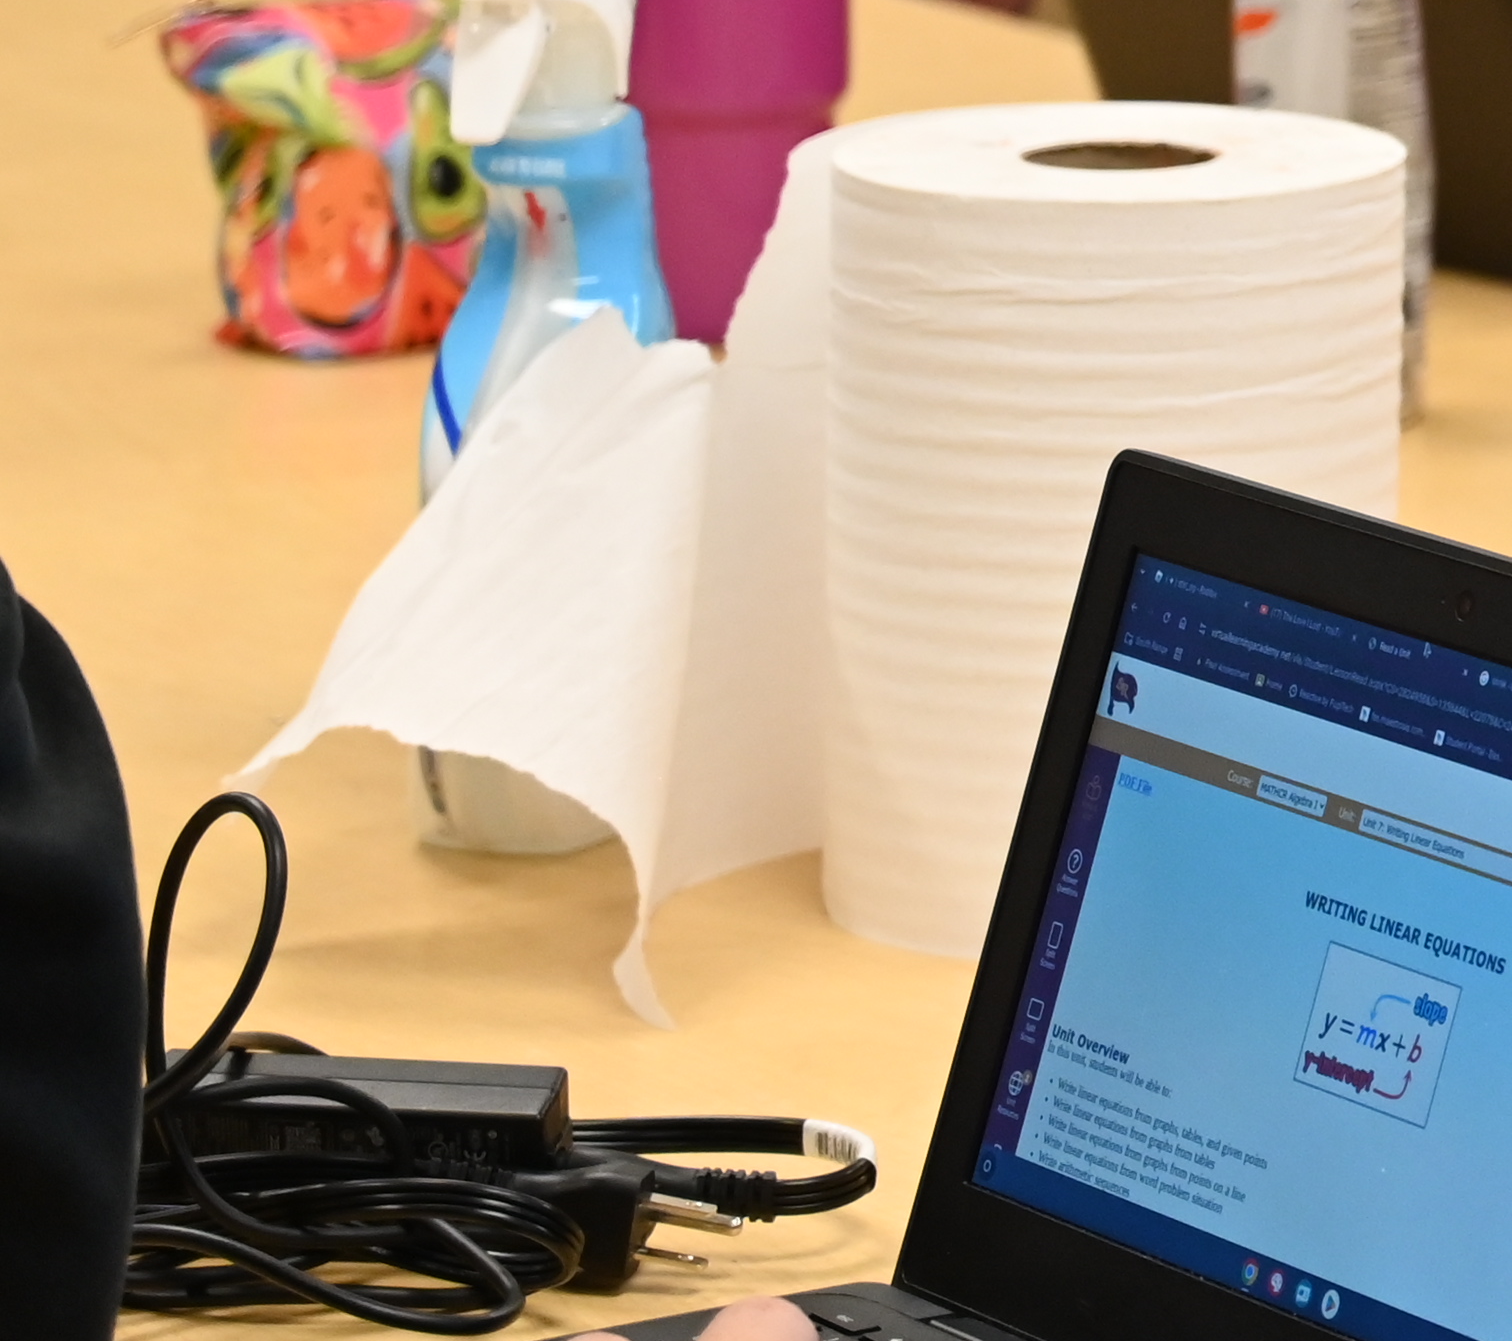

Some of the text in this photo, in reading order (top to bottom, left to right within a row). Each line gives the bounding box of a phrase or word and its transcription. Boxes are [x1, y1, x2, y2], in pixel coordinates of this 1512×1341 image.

[1289, 790, 1313, 809] Algebra
[1363, 818, 1378, 829] Unit
[1387, 824, 1409, 843] Writing
[1411, 833, 1431, 848] Linear
[1432, 840, 1465, 859] Equations
[1305, 890, 1507, 975] WRITING LINEAR EQUATIONS
[1413, 993, 1448, 1027] slope
[1052, 1024, 1130, 1065] Unit Overview
[1057, 1044, 1070, 1059] this
[1089, 1058, 1118, 1078] students
[1120, 1068, 1134, 1084] will
[1135, 1073, 1144, 1087] be
[1145, 1079, 1159, 1094] able
[1161, 1085, 1172, 1099] to:
[1303, 1050, 1375, 1094] y-intercept
[1053, 1096, 1215, 1169] Write linear equations from graphs from tables
[1058, 1078, 1268, 1169] Write linear equations from graphs, tables, and given points
[1043, 1132, 1223, 1214] Write linear equations from word problem situation
[1048, 1114, 1246, 1203] Write linear equations from graphs from points on a line
